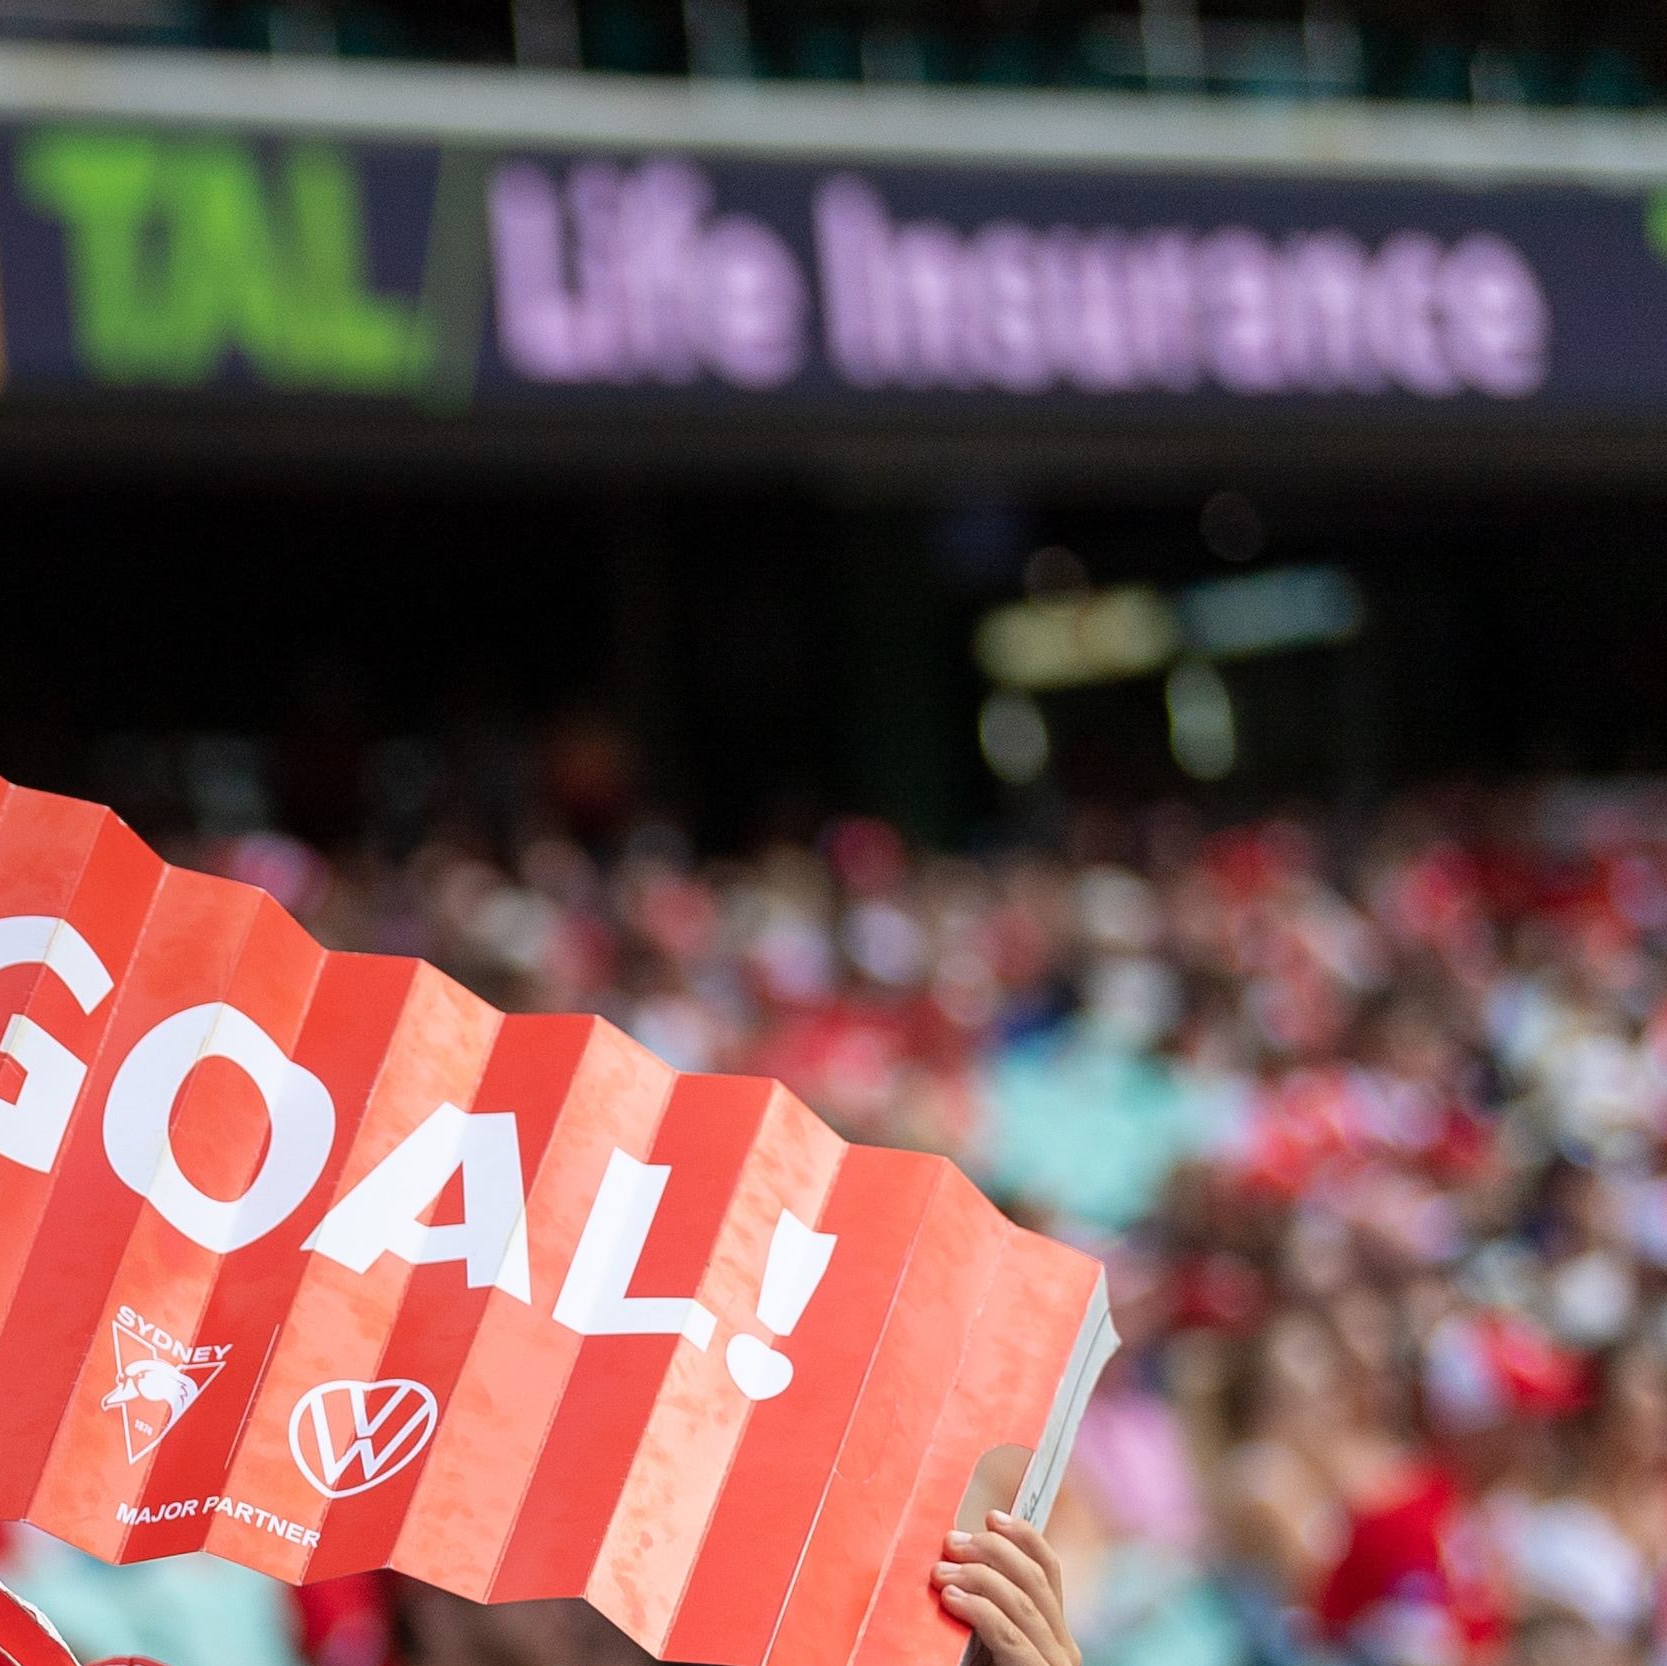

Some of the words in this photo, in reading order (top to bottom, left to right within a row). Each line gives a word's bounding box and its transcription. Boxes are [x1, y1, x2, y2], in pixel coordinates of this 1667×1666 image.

[22, 130, 437, 388] TAL
[490, 158, 805, 388] Life
[816, 172, 1549, 398] Insurance
[116, 1304, 233, 1362] SYDNEY
[116, 1499, 198, 1526] MAJOR
[202, 1495, 321, 1549] PARTNER
